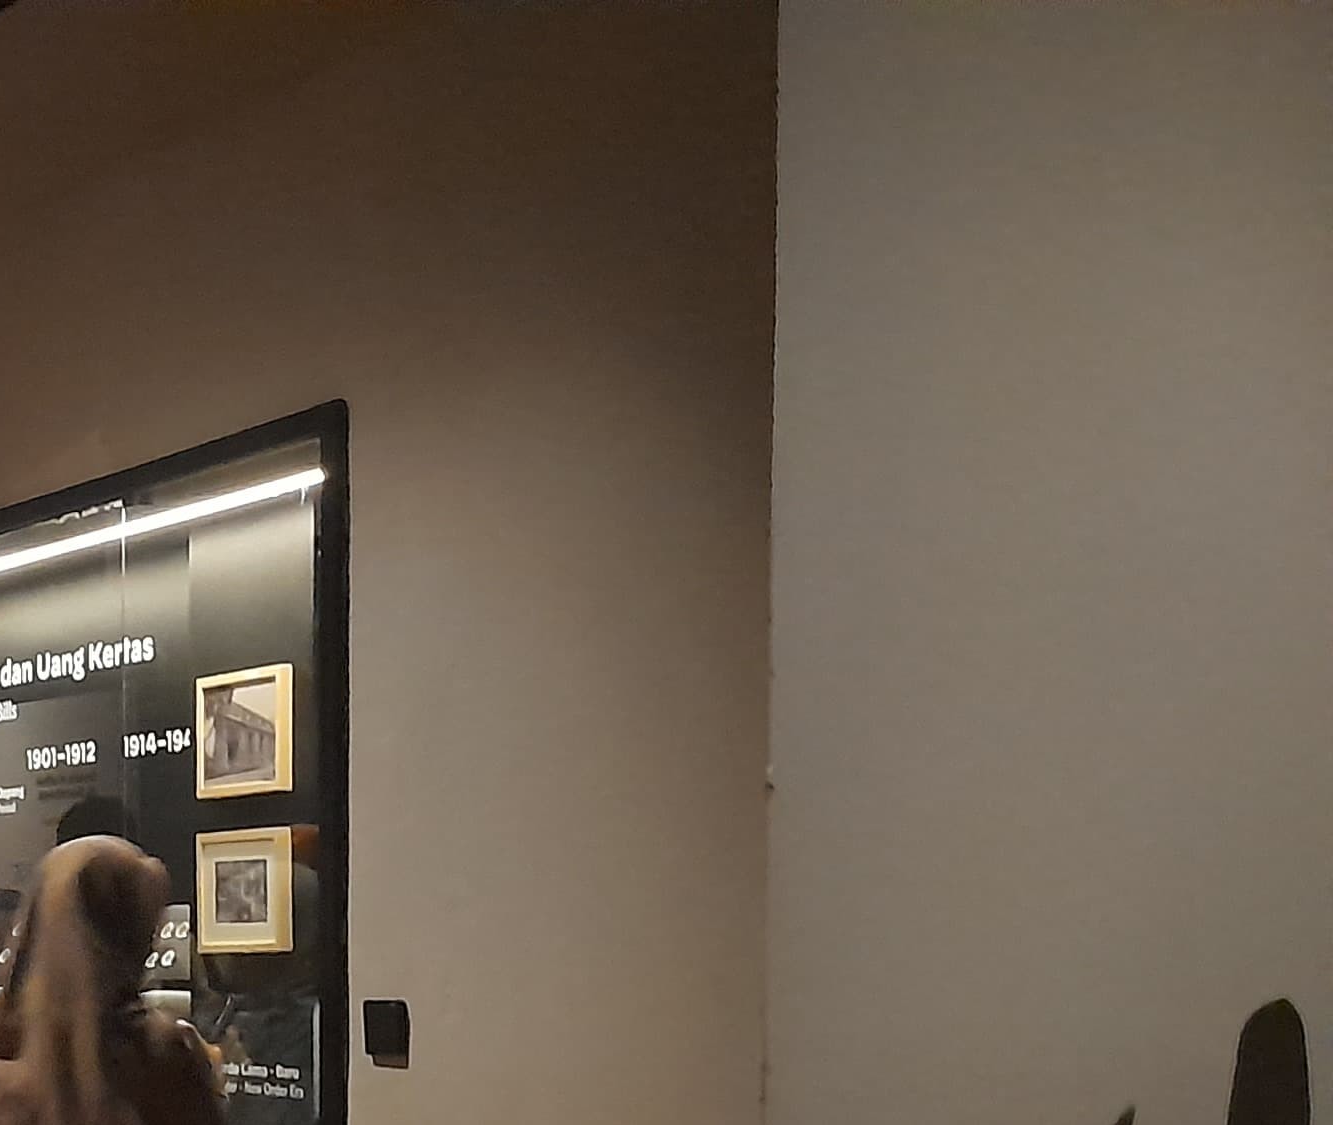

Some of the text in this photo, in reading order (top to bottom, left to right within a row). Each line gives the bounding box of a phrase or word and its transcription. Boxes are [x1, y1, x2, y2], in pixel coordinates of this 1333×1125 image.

[0, 657, 33, 688] dan
[36, 646, 85, 681] Uang
[88, 636, 155, 671] Kertas
[26, 741, 97, 770] 1901-1912
